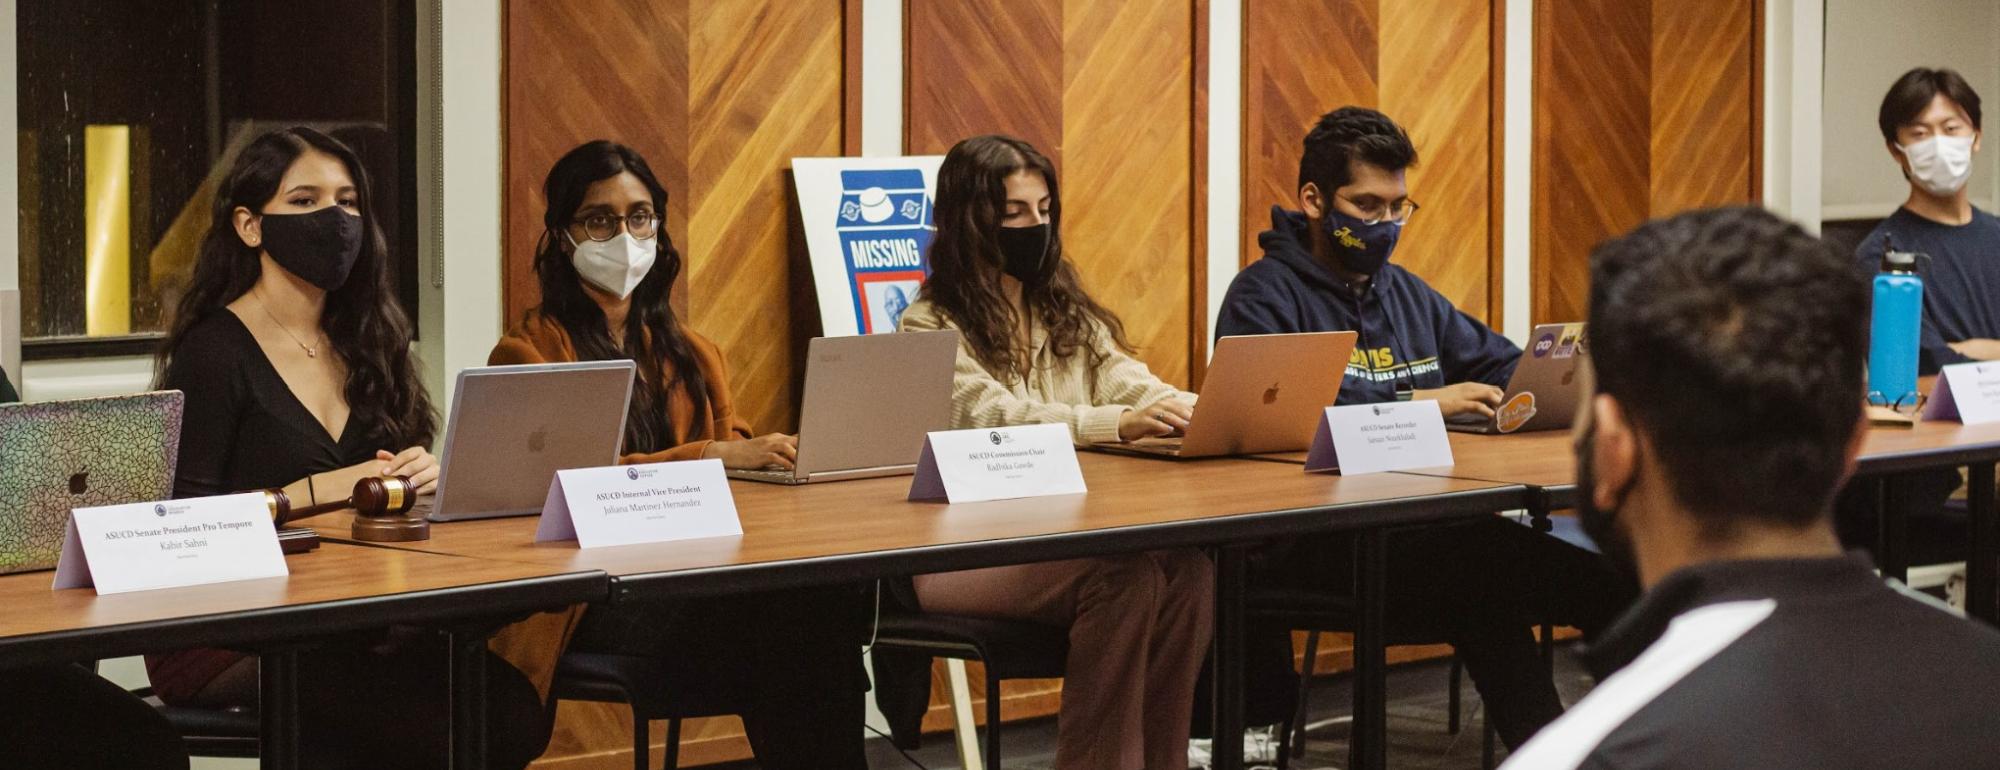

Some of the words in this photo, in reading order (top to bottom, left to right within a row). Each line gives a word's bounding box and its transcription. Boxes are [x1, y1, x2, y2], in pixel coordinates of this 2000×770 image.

[850, 238, 920, 268] MISSING
[596, 491, 621, 502] ASUCD
[621, 488, 651, 499] Internal
[651, 487, 668, 497] Vice
[667, 485, 702, 495] President
[603, 504, 629, 516] Juliana
[661, 498, 702, 510] Hernandez
[104, 529, 134, 541] ASUCD
[134, 527, 162, 539] Senate
[162, 523, 201, 536] President
[202, 521, 217, 532] Pro
[217, 519, 253, 531] Tempore
[159, 540, 183, 551] Kabir
[183, 537, 208, 549] Sahni
